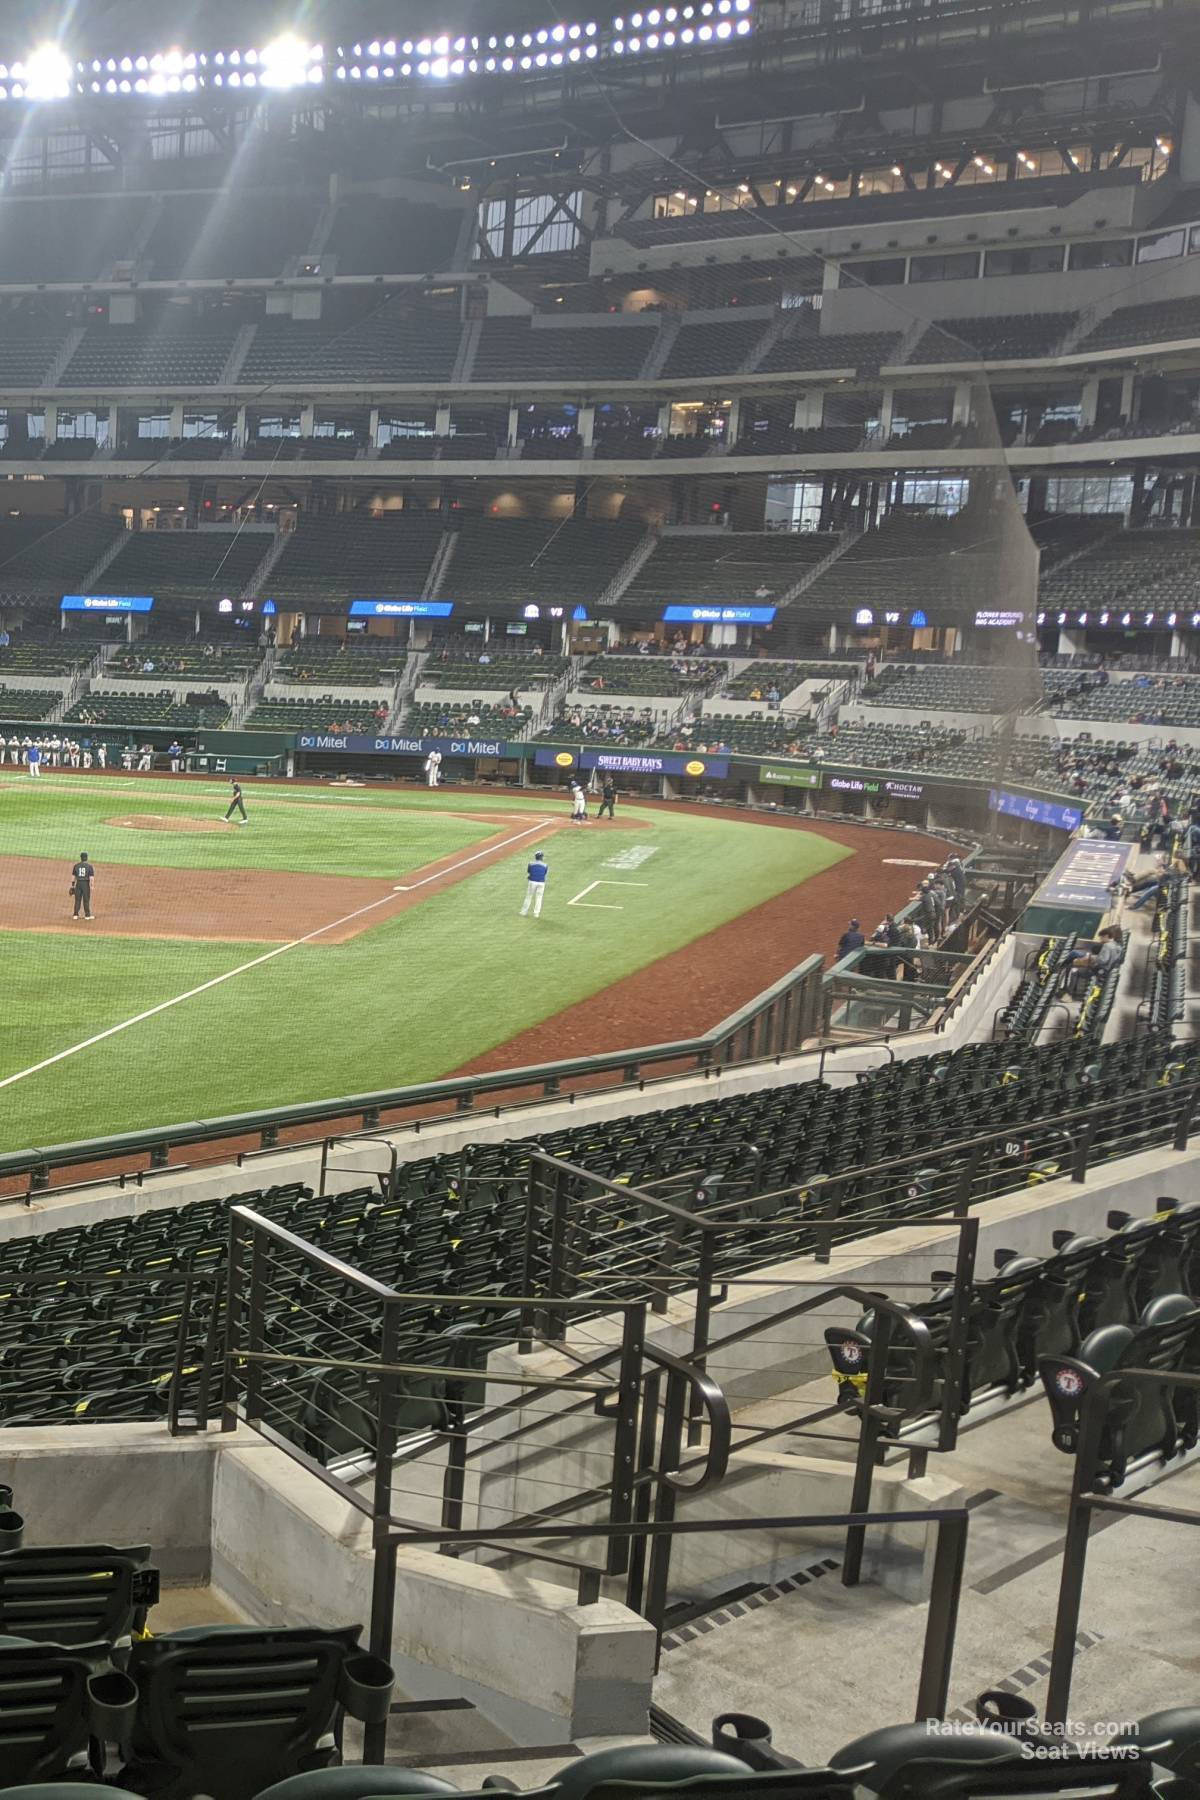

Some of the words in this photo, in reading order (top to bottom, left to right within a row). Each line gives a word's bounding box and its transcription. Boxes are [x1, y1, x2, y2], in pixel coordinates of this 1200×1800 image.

[242, 601, 253, 610] VS
[551, 607, 563, 616] VS
[885, 612, 899, 622] VS
[1037, 612, 1046, 625] 2
[1057, 612, 1067, 625] 3
[1078, 612, 1087, 625] 4
[1100, 613, 1109, 625] 5
[1122, 613, 1131, 625] 6
[1145, 613, 1154, 625] 7
[1168, 613, 1177, 625] 8
[317, 736, 347, 749] Mitel
[391, 738, 423, 751] Mitel
[467, 741, 500, 754] Mitel
[598, 755, 621, 766] SWEET
[622, 756, 642, 767] BABY
[831, 778, 851, 789] Globe
[851, 780, 864, 791] Life
[864, 781, 879, 792] Field
[890, 782, 923, 793] CHOCTAW
[1005, 1142, 1020, 1157] 02
